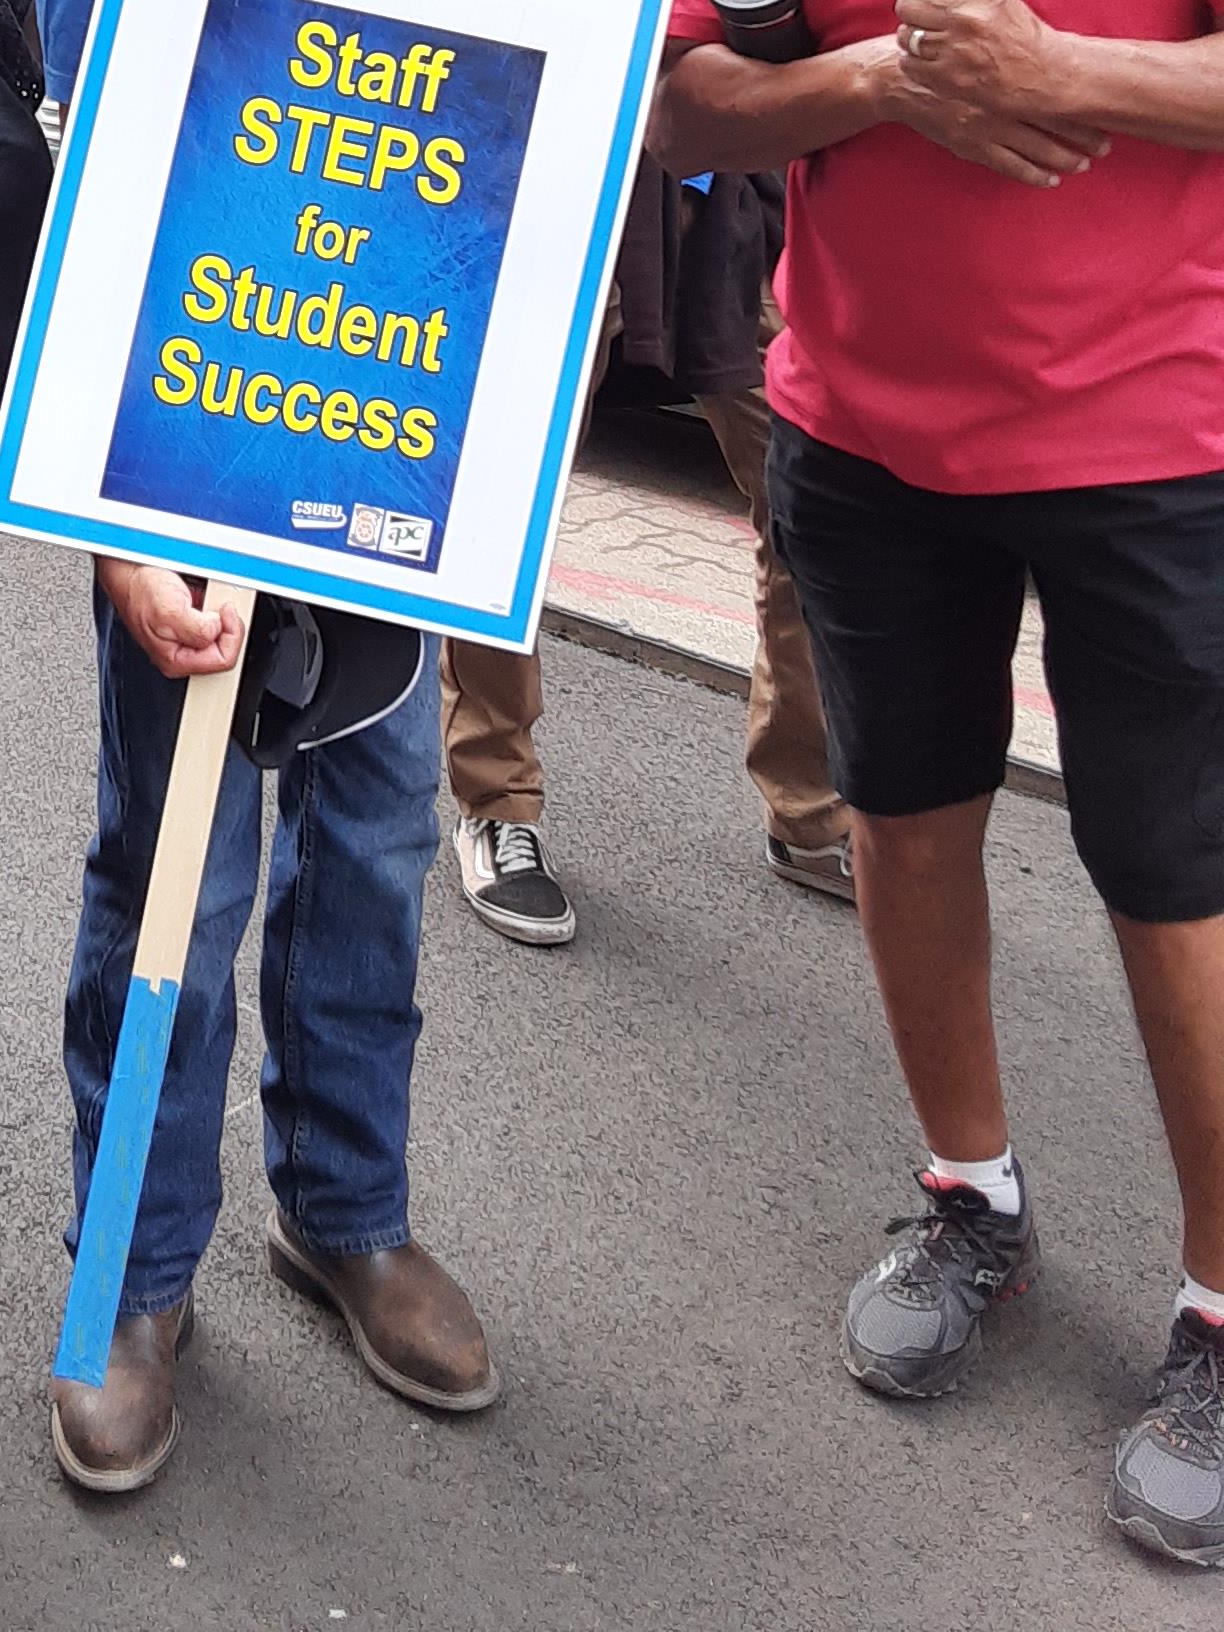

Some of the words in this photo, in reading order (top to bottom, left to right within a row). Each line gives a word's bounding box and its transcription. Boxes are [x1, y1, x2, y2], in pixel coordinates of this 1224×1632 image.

[287, 18, 457, 114] Staff
[233, 96, 467, 207] STEPS
[294, 204, 371, 266] for
[182, 252, 449, 376] Student
[152, 336, 439, 461] Success
[291, 500, 344, 518] CSUEU
